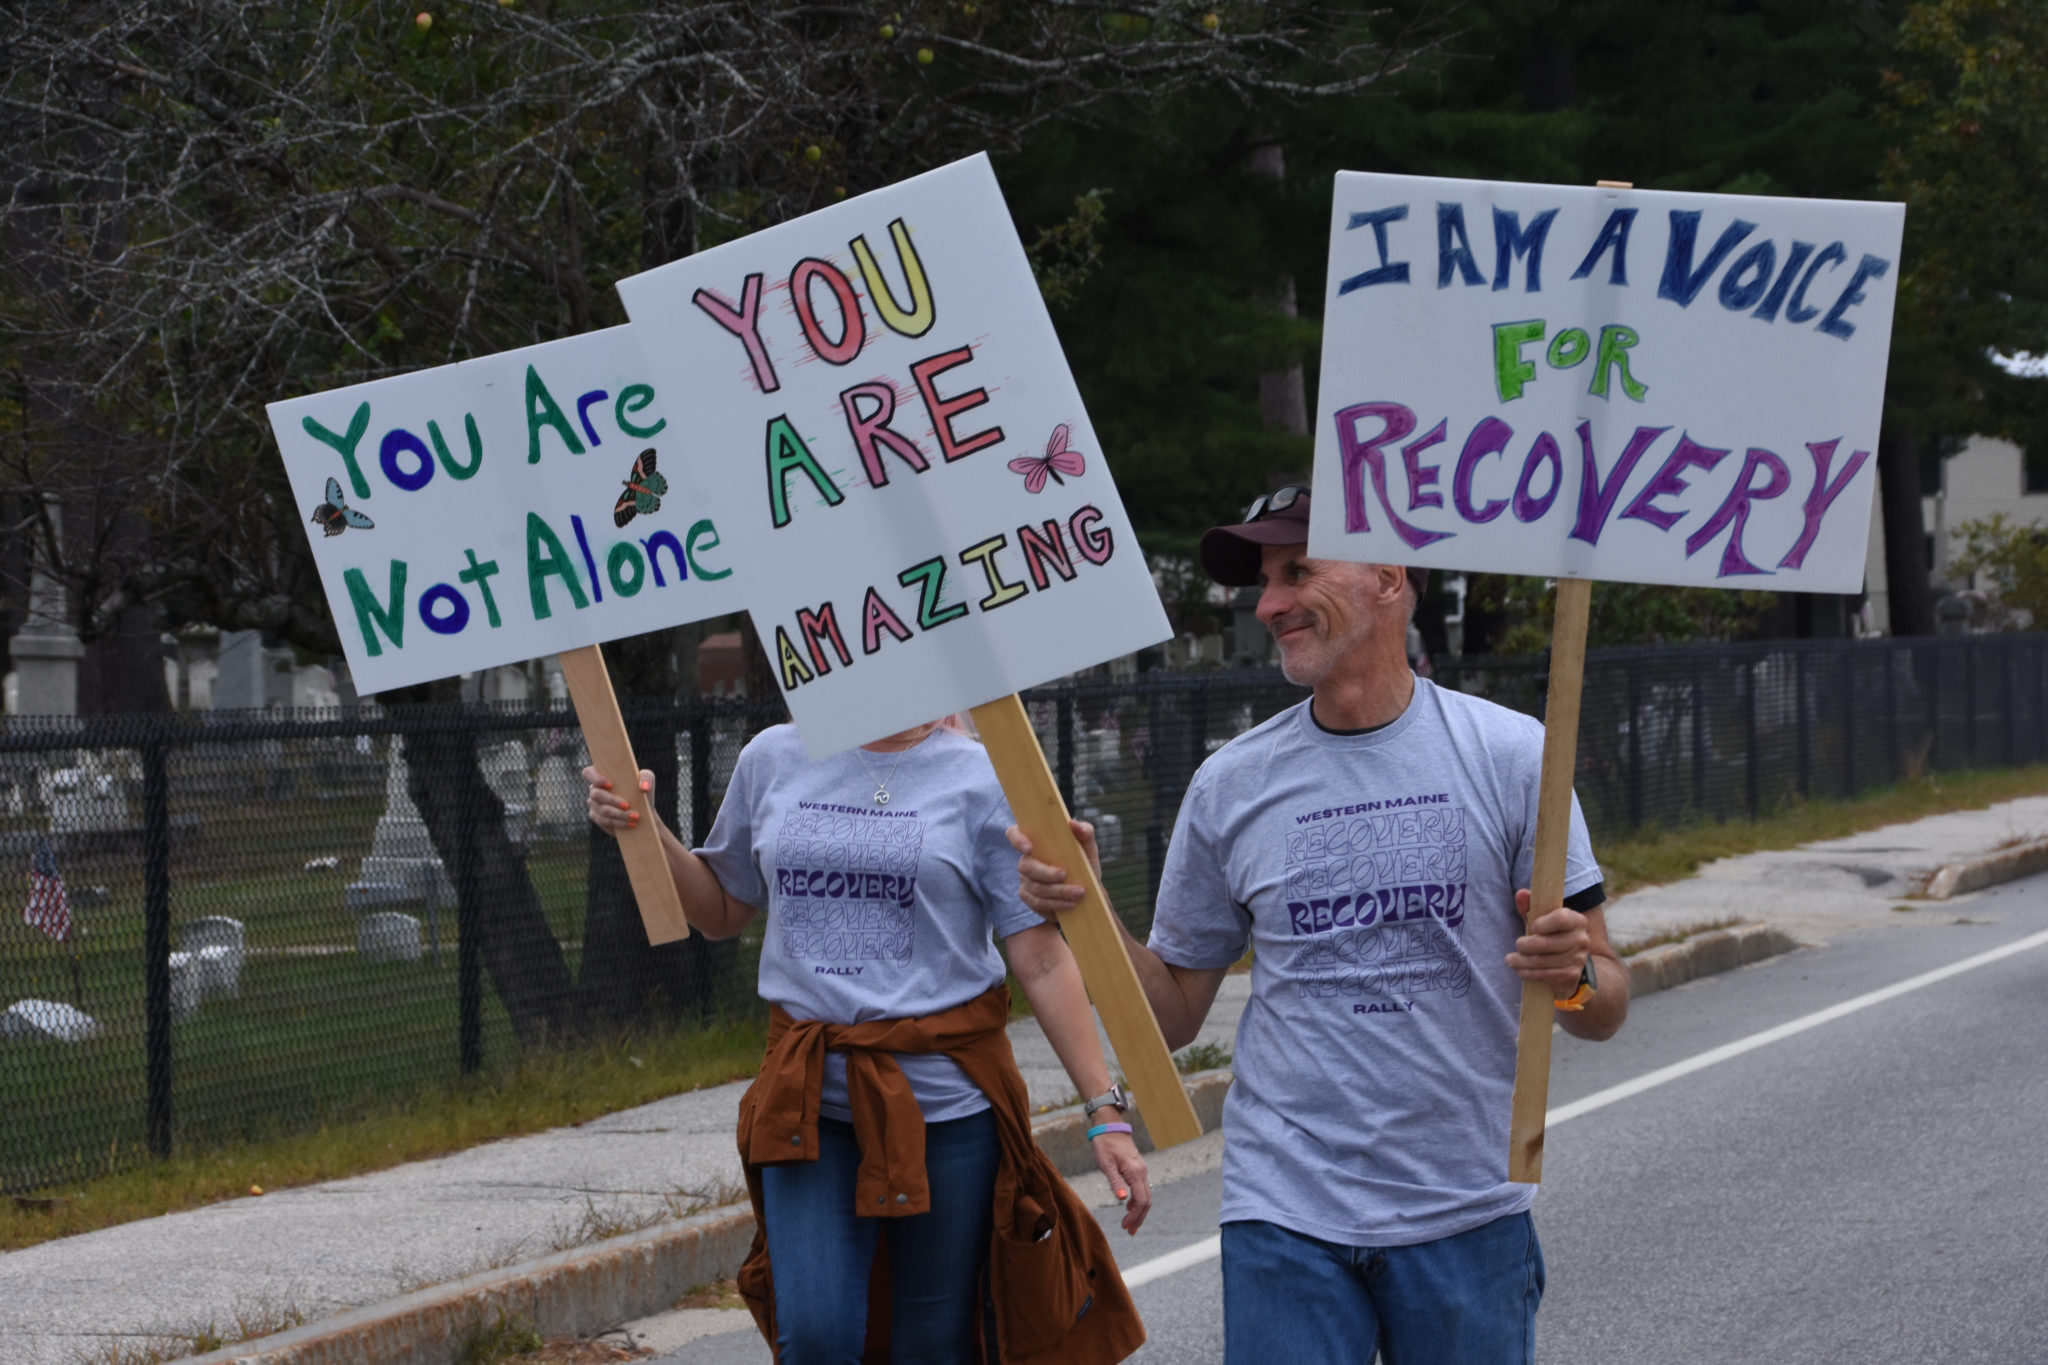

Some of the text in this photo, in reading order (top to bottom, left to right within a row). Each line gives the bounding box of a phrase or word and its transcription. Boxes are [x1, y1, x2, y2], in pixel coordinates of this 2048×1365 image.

[691, 216, 936, 394] YOU
[1338, 201, 1891, 341] I AM A VOICE
[1491, 319, 1649, 403] FOR
[525, 363, 668, 465] Are
[765, 344, 1006, 529] ARE
[1333, 401, 1871, 579] RECOVERY
[343, 511, 733, 657] Not Alone
[772, 504, 1115, 691] AMAZING
[799, 801, 919, 818] WESTERN MAINE
[1285, 807, 1466, 865] RECOVERY
[1296, 793, 1450, 825] WESTERN MAINE
[776, 868, 917, 908] RECOVERY
[1287, 883, 1467, 936] RECOVERY
[815, 966, 864, 975] RALLY
[1353, 1001, 1416, 1014] RALLY
